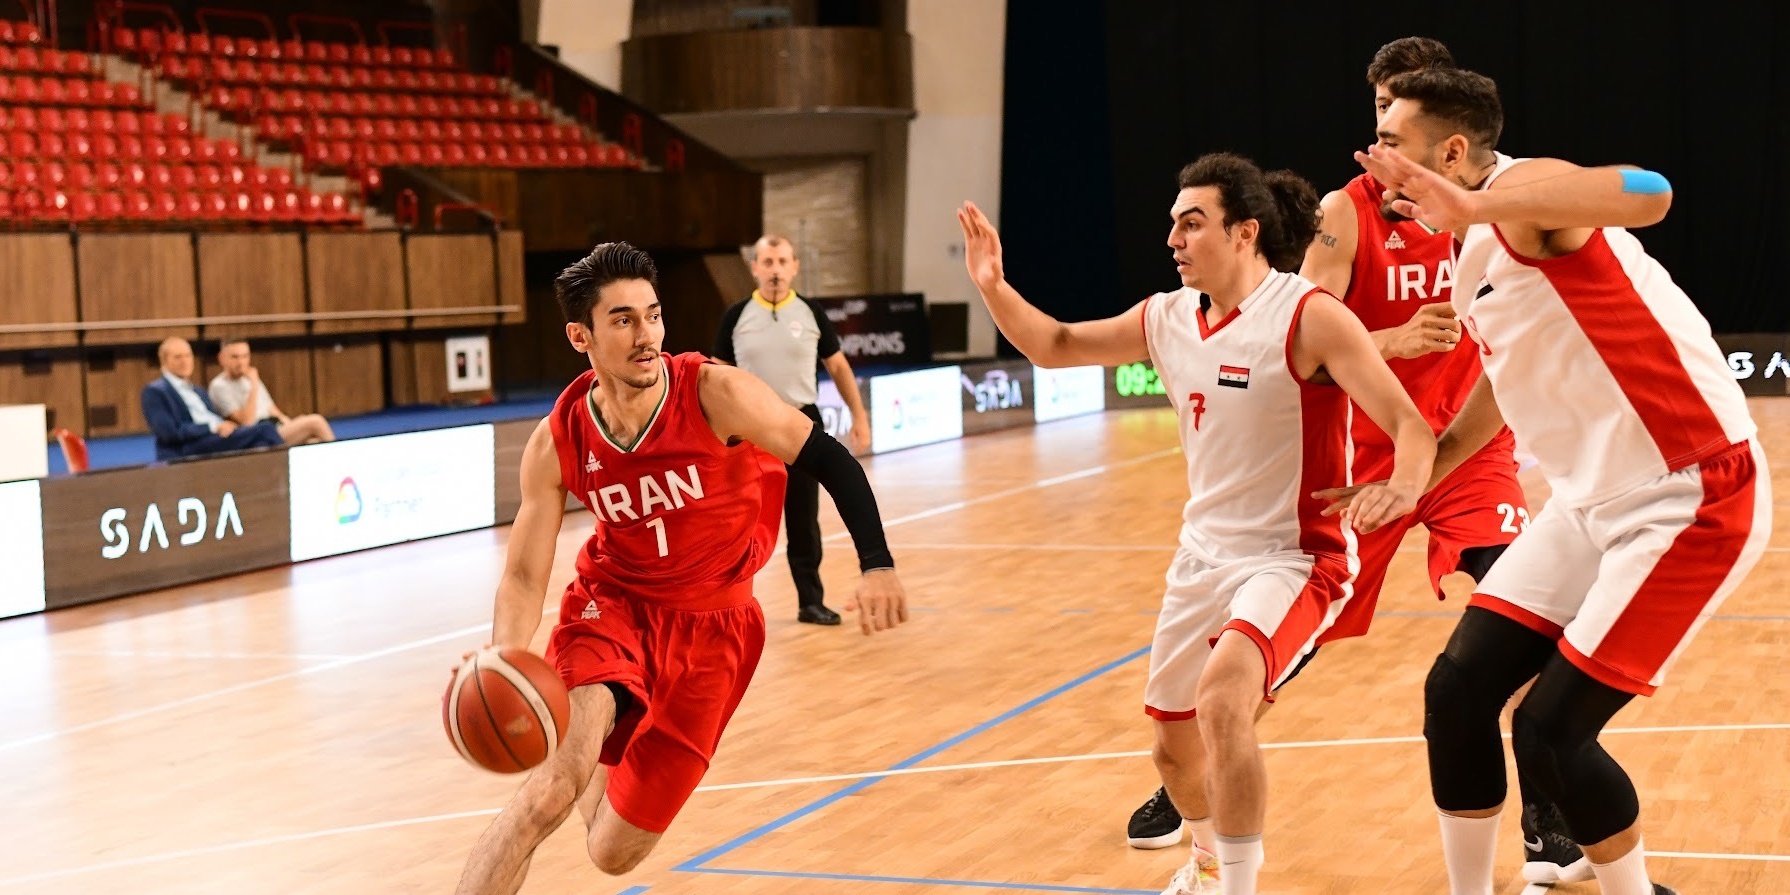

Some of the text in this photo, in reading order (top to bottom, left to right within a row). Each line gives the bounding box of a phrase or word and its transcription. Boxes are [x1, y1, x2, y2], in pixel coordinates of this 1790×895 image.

[1384, 240, 1406, 250] PEAK
[1188, 392, 1206, 432] 7
[587, 464, 705, 523] IRAN
[100, 491, 244, 560] SADA
[645, 516, 669, 558] 1
